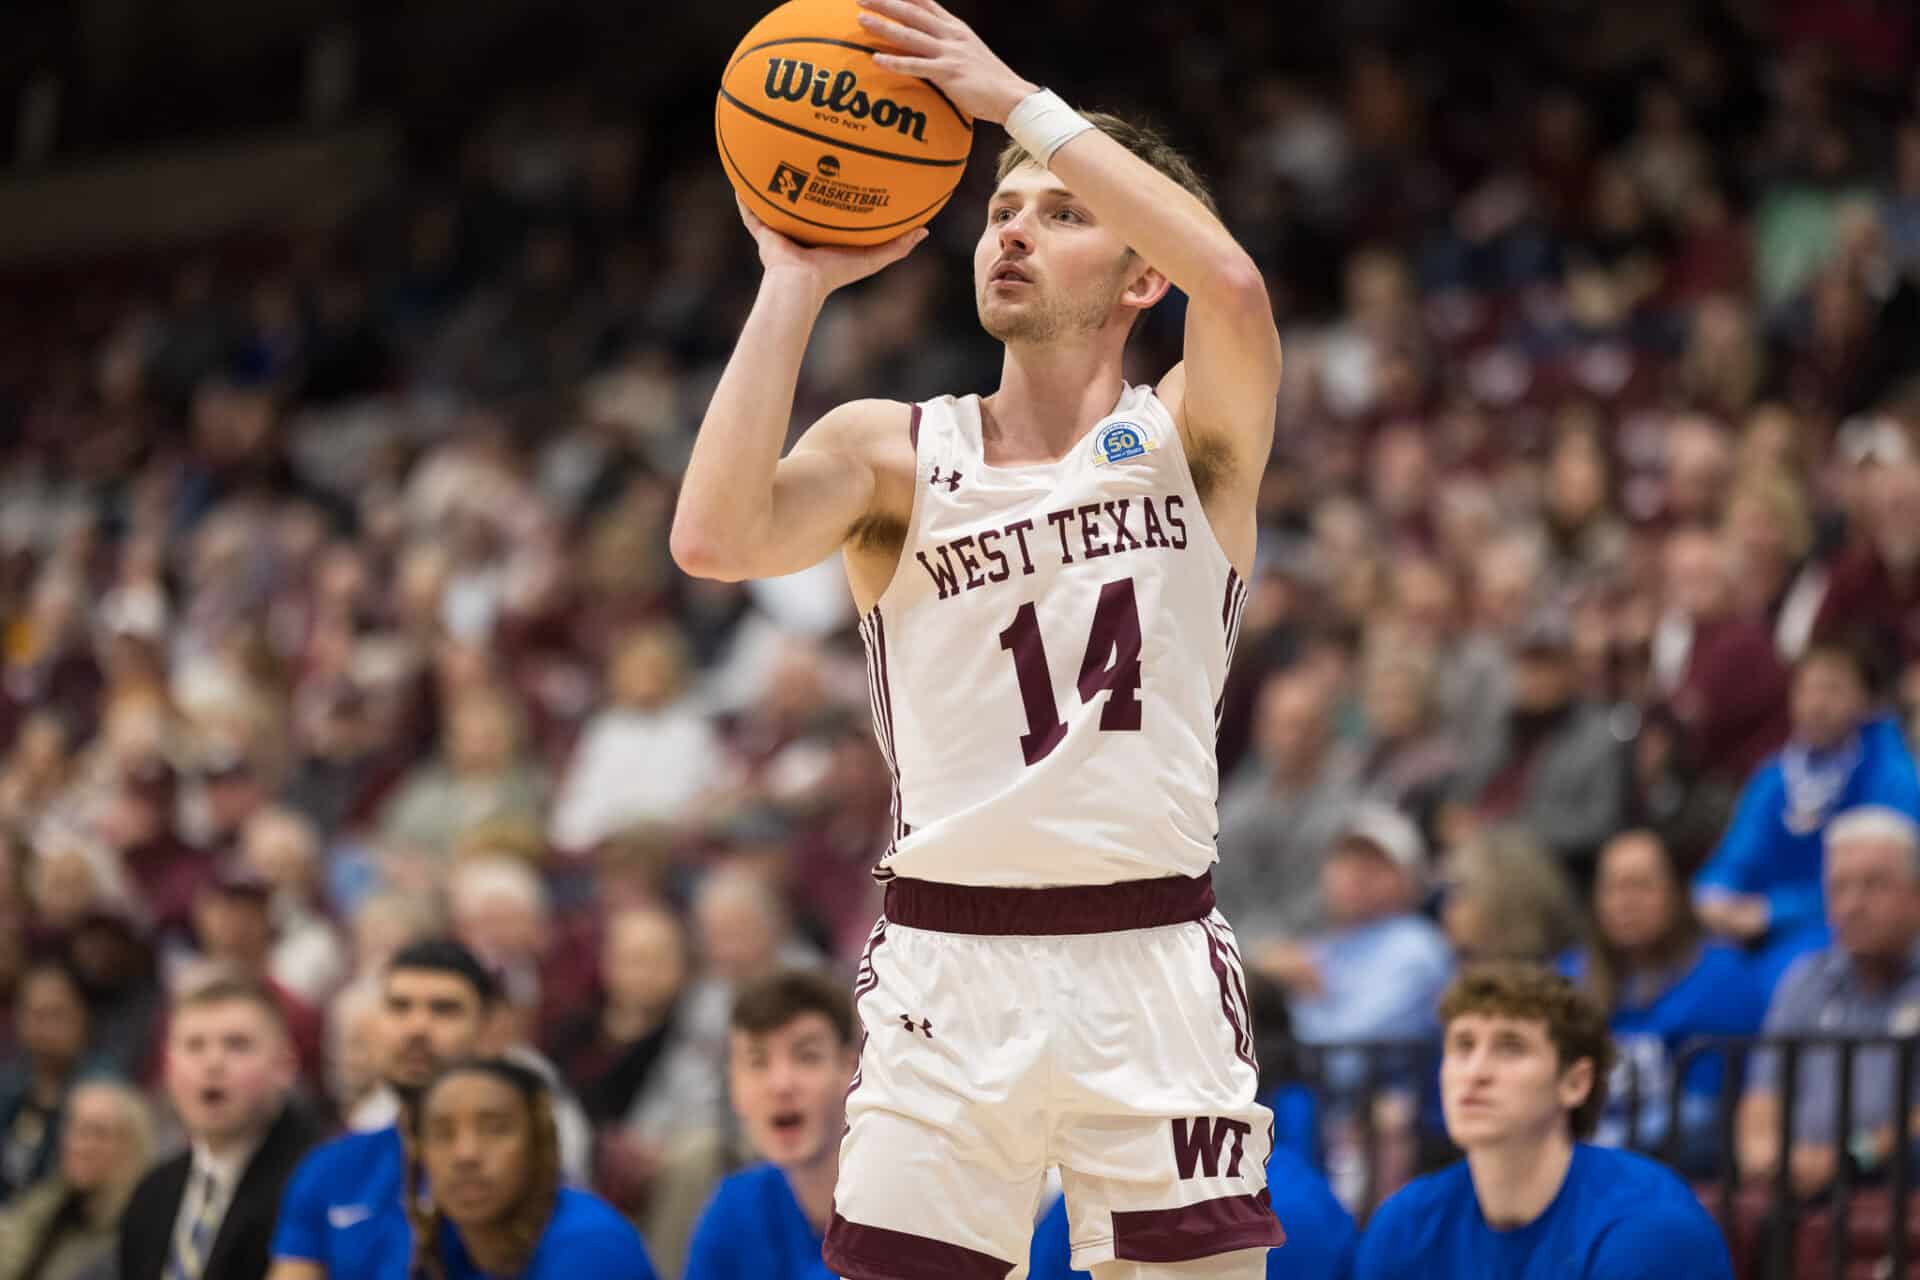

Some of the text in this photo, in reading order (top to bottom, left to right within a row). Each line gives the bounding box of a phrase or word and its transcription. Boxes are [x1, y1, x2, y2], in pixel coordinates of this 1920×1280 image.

[764, 57, 928, 144] Wilson
[814, 111, 869, 132] EVO NXT
[808, 181, 890, 207] BASKETBALL
[1108, 433, 1135, 453] 50
[916, 495, 1187, 600] WEST TEXAS
[999, 576, 1142, 767] 14
[1171, 1116, 1251, 1180] WT
